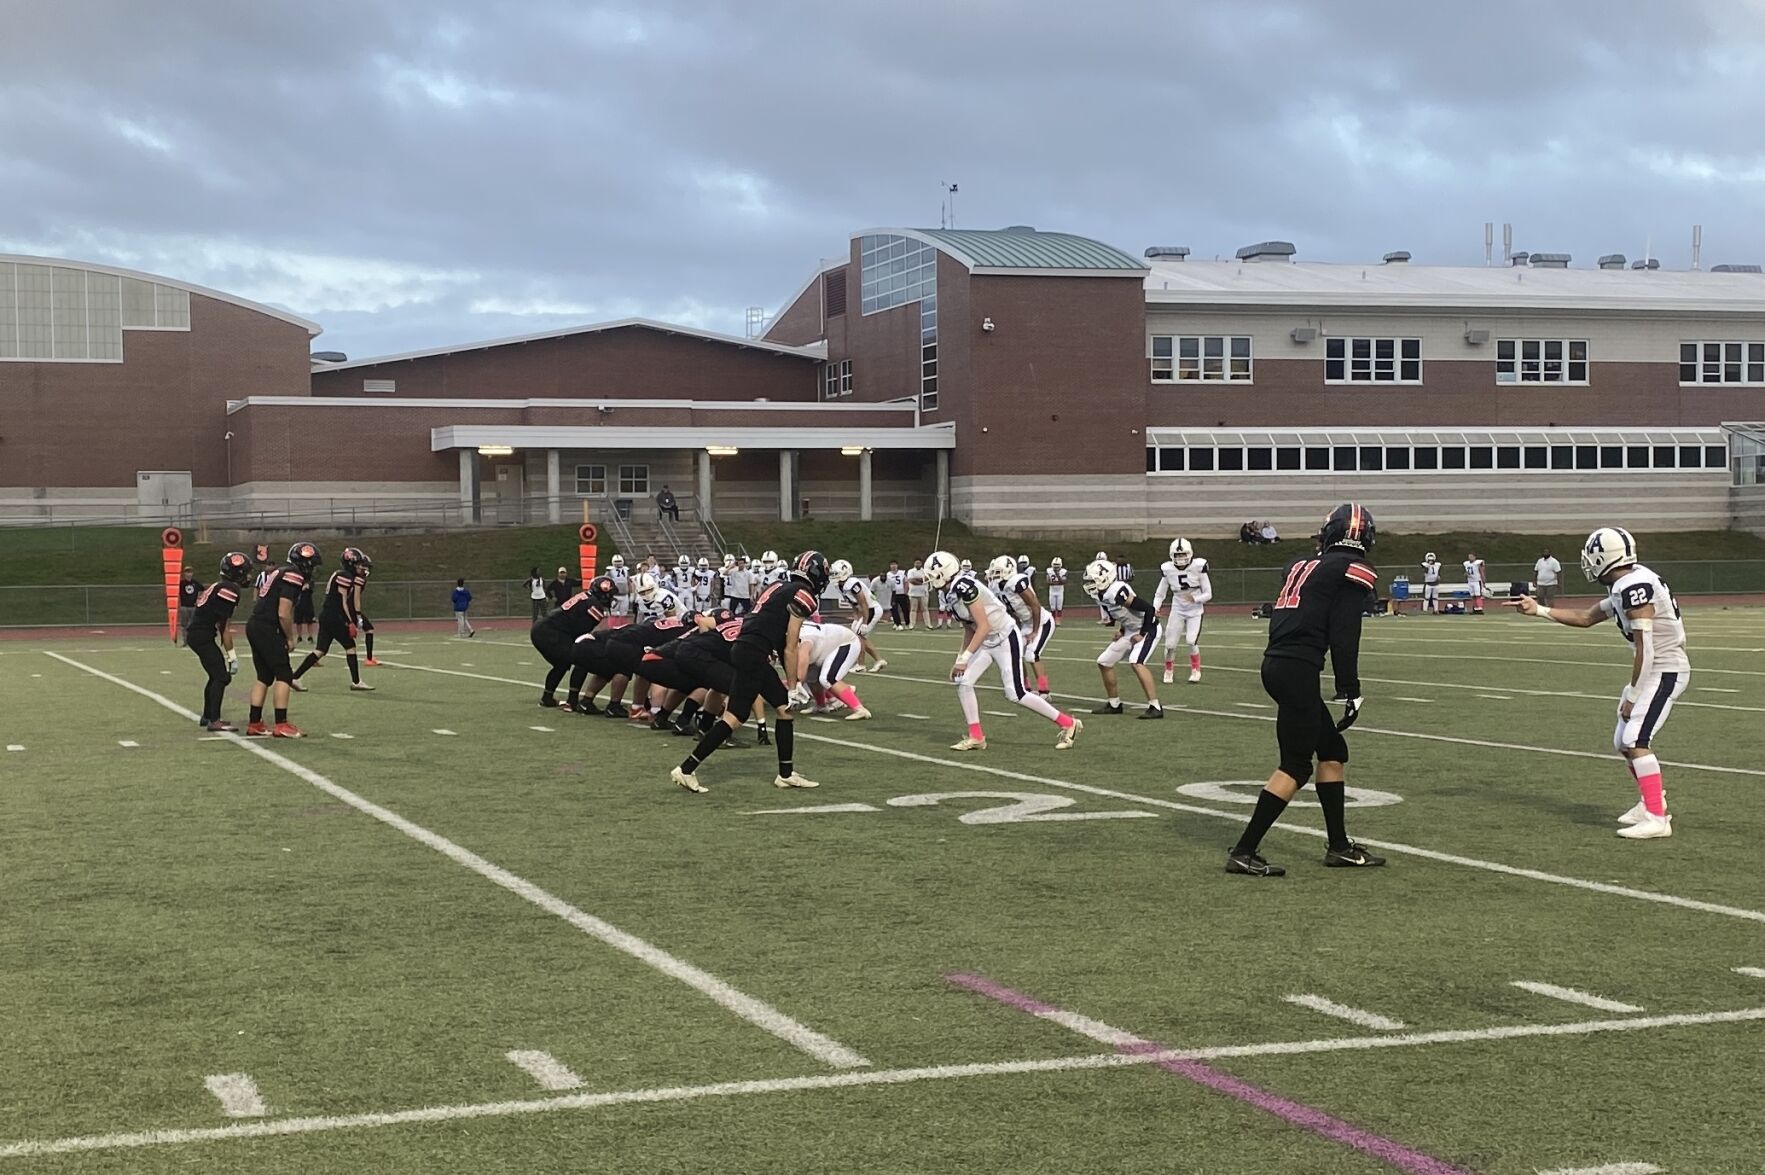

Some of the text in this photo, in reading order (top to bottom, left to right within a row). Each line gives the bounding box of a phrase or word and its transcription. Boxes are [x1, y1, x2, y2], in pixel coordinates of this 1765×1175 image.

[1587, 533, 1604, 554] A
[256, 544, 268, 562] 3
[931, 555, 943, 570] A
[682, 573, 688, 583] 3
[895, 575, 901, 585] 5
[1178, 574, 1190, 591] 5
[1275, 560, 1321, 609] 11
[1628, 587, 1649, 606] 22
